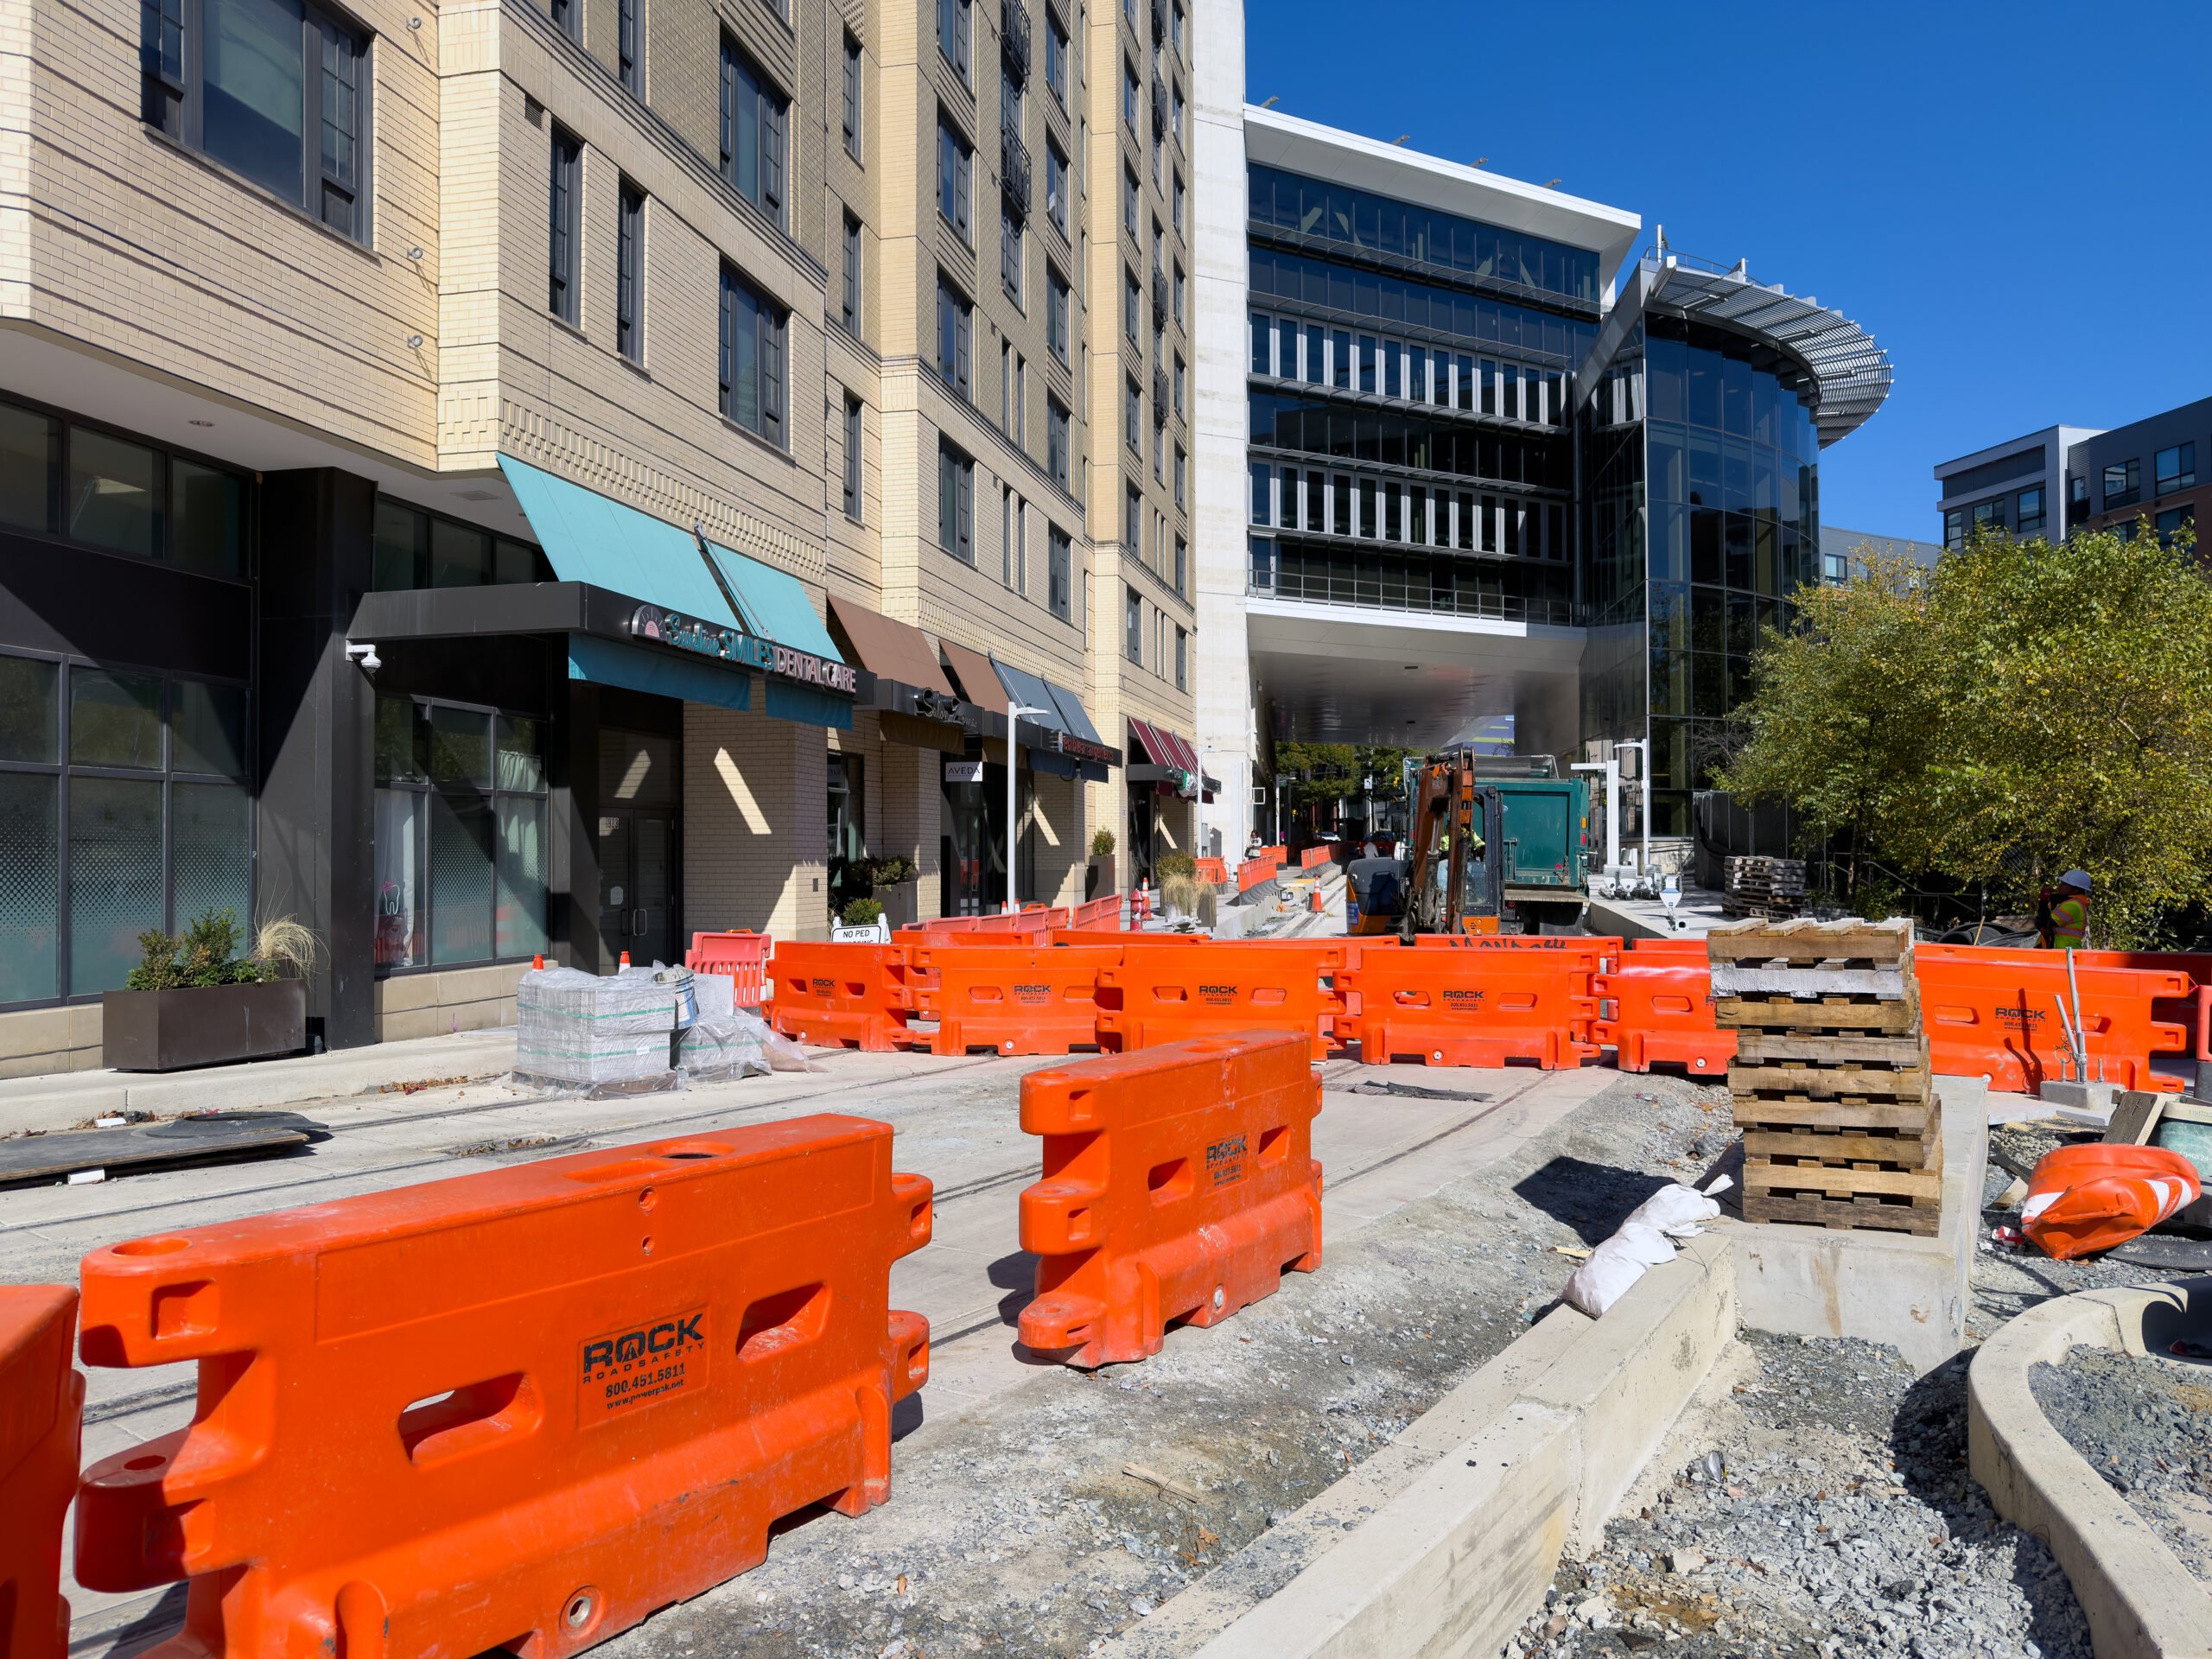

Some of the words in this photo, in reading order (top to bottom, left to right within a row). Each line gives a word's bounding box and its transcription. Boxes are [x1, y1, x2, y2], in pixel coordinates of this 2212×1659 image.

[721, 630, 774, 671] SMILES
[774, 646, 824, 684] DENTAL
[823, 661, 856, 693] CARE
[812, 978, 835, 987] ROCK
[1443, 990, 1484, 999] ROCK
[1995, 1007, 2046, 1019] ROCK
[1207, 1135, 1247, 1163] ROCK
[583, 1313, 704, 1373] ROCK
[606, 1363, 684, 1397] 800.451.5811
